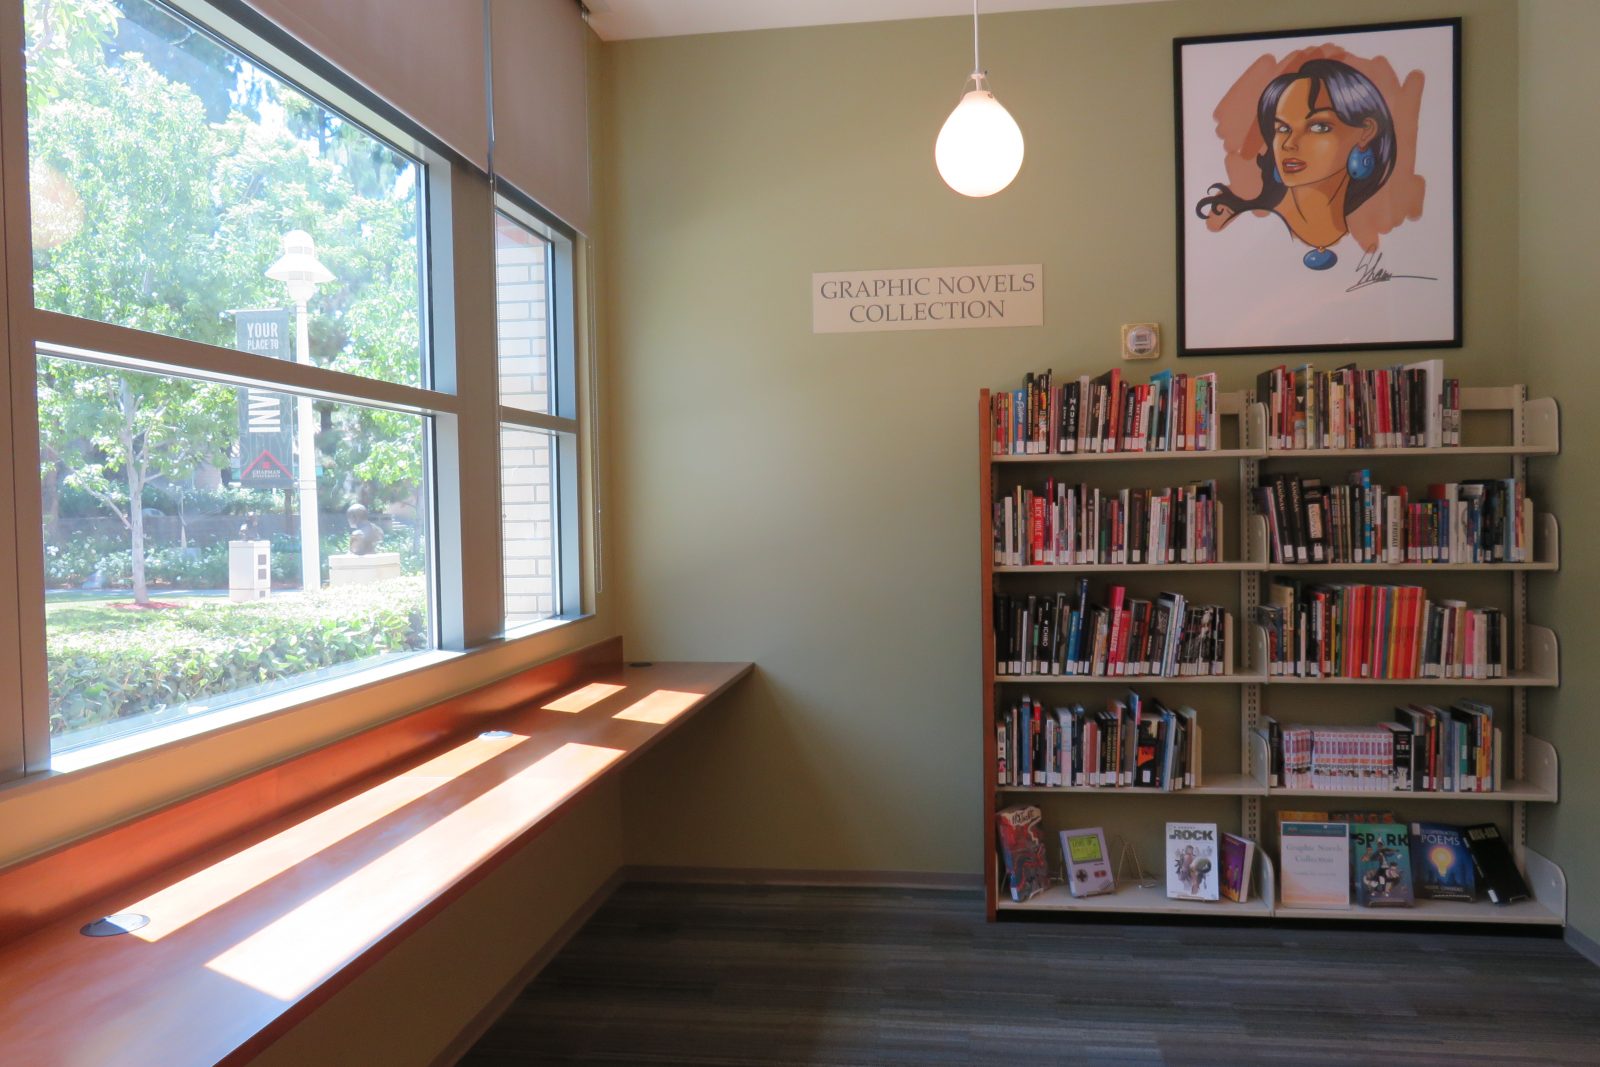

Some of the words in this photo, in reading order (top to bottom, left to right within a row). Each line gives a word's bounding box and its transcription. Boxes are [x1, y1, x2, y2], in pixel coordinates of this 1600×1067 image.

[820, 277, 931, 299] GRAPHIC
[937, 273, 1036, 295] NOVELS
[849, 299, 1005, 323] COLLECTION
[247, 322, 278, 338] YOUR
[247, 338, 269, 350] PLACE
[270, 338, 279, 350] TO
[247, 386, 281, 433] INV
[1034, 498, 1043, 517] BLACK
[1034, 519, 1043, 537] HOLE
[1391, 521, 1400, 548] JERUSALE
[1173, 829, 1214, 841] ROCK
[1420, 833, 1461, 846] POEMS
